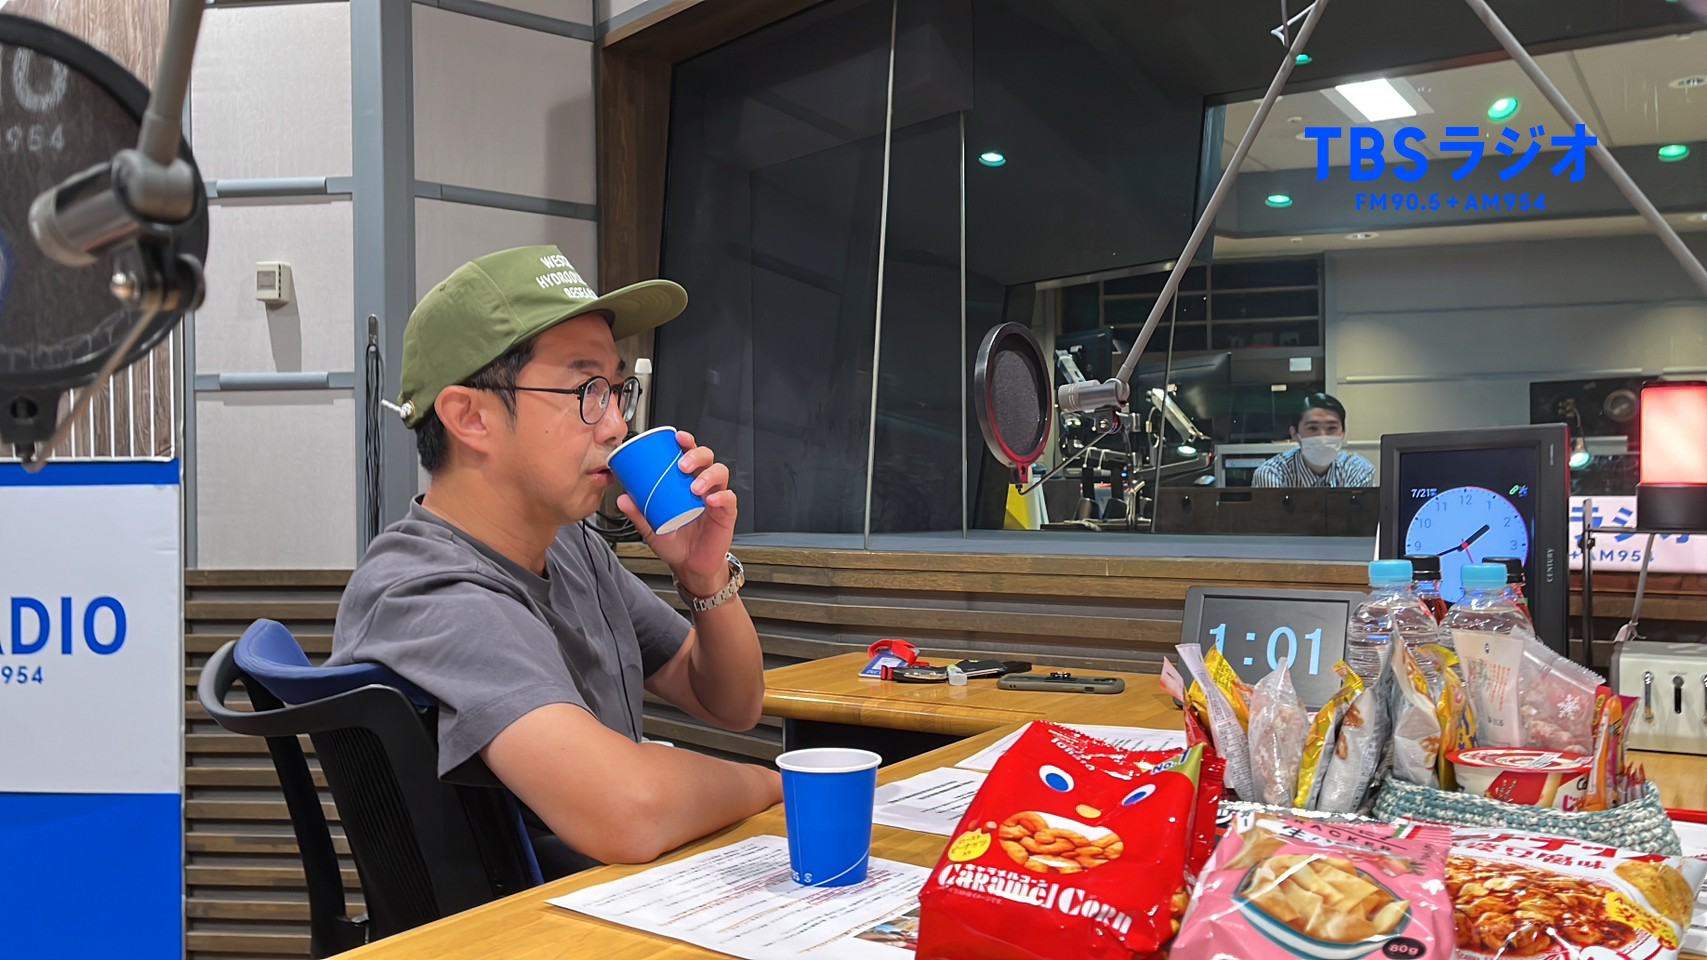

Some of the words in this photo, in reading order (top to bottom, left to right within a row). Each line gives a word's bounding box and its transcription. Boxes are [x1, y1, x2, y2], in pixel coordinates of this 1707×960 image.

[1460, 495, 1472, 505] 12
[1436, 502, 1447, 511] 11
[1420, 518, 1432, 529] 10
[1503, 516, 1511, 527] 2
[1569, 506, 1690, 544] ラジ
[1414, 540, 1422, 551] 9
[1510, 540, 1518, 551] 3
[0, 596, 127, 655] DIO
[1209, 623, 1323, 675] 1:01
[1390, 943, 1419, 956] 80g
